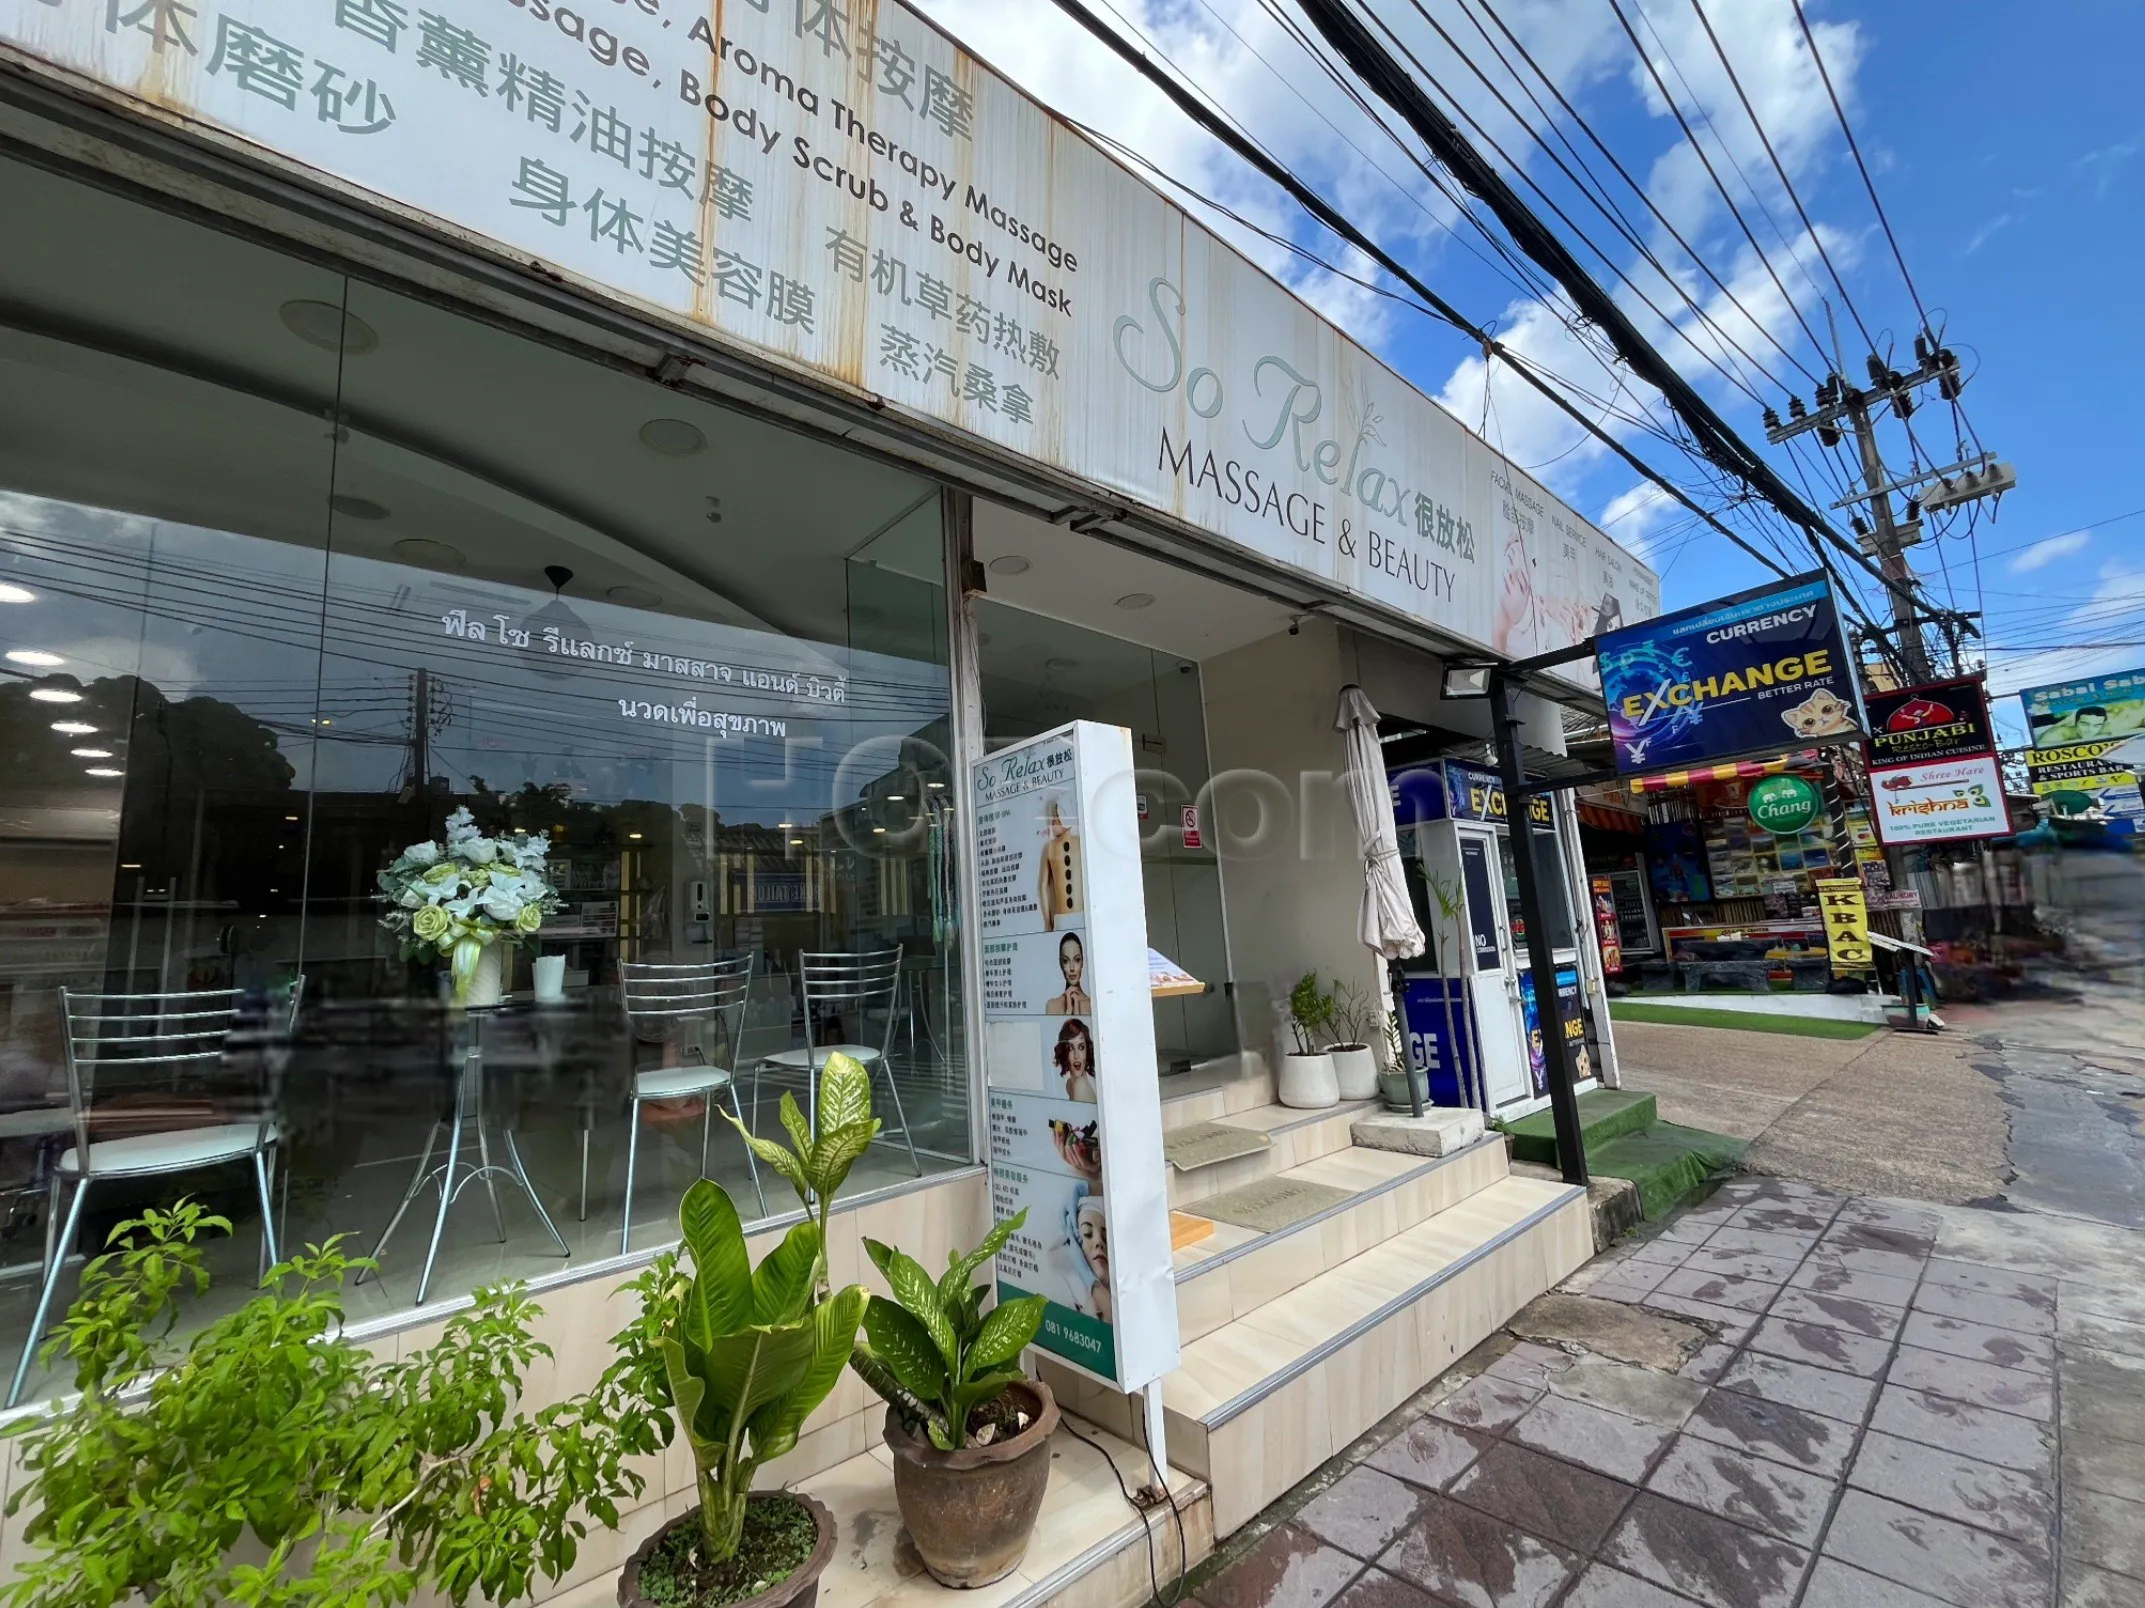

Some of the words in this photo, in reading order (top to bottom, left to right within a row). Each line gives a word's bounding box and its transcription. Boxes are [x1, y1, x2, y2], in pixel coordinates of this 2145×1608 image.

[687, 15, 819, 117] Aroma
[831, 98, 956, 201] Therapy
[965, 184, 1078, 273] Massage
[680, 68, 782, 155] Body
[793, 136, 888, 212] Scrub
[899, 200, 919, 232] &
[931, 213, 1000, 278] Body
[1007, 260, 1072, 318] Mask
[508, 155, 816, 336] 身体美容膜
[825, 225, 1060, 381] 有机草药热敷
[879, 322, 1034, 425] 蒸汽桑拿
[1112, 276, 1224, 420] So
[1241, 354, 1411, 527] Relax
[1490, 470, 1513, 497] FACIAL
[1514, 487, 1545, 518] MASSAGE
[1157, 424, 1326, 545] MASSAGE
[1338, 517, 1357, 559] &
[1368, 530, 1456, 603] BEAUTY
[1414, 491, 1475, 565] 很放松
[1565, 523, 1587, 548] SERVICE
[1705, 603, 1818, 645] CURRENCY
[1623, 649, 1833, 725] EXCHANGE
[1757, 684, 1801, 700] BETTER
[1803, 676, 1835, 692] RATE
[617, 696, 787, 740] นวดเพื่อสุขภาพ
[1873, 722, 1977, 748] PUNJABI
[977, 766, 997, 791] So
[1001, 755, 1047, 783] Relax
[1871, 757, 1895, 766] KING
[1895, 755, 1909, 763] OF
[1910, 751, 1945, 761] INDIAN
[1920, 769, 1951, 782] Shree
[1954, 766, 1985, 777] Hare
[2049, 769, 2096, 780] SPORTS
[2099, 763, 2125, 775] BAR
[984, 780, 1022, 802] MASSAGE
[1032, 767, 1065, 789] BEAUTY
[1757, 800, 1812, 819] Chang
[1889, 823, 1912, 832] 100%
[1912, 821, 1936, 830] PURE
[1938, 816, 1996, 827] VEGETARIAN
[1914, 824, 1974, 836] RESTAURANT
[1474, 933, 1488, 948] NO
[1045, 1318, 1061, 1337] 081
[1063, 1325, 1102, 1354] 9683047
